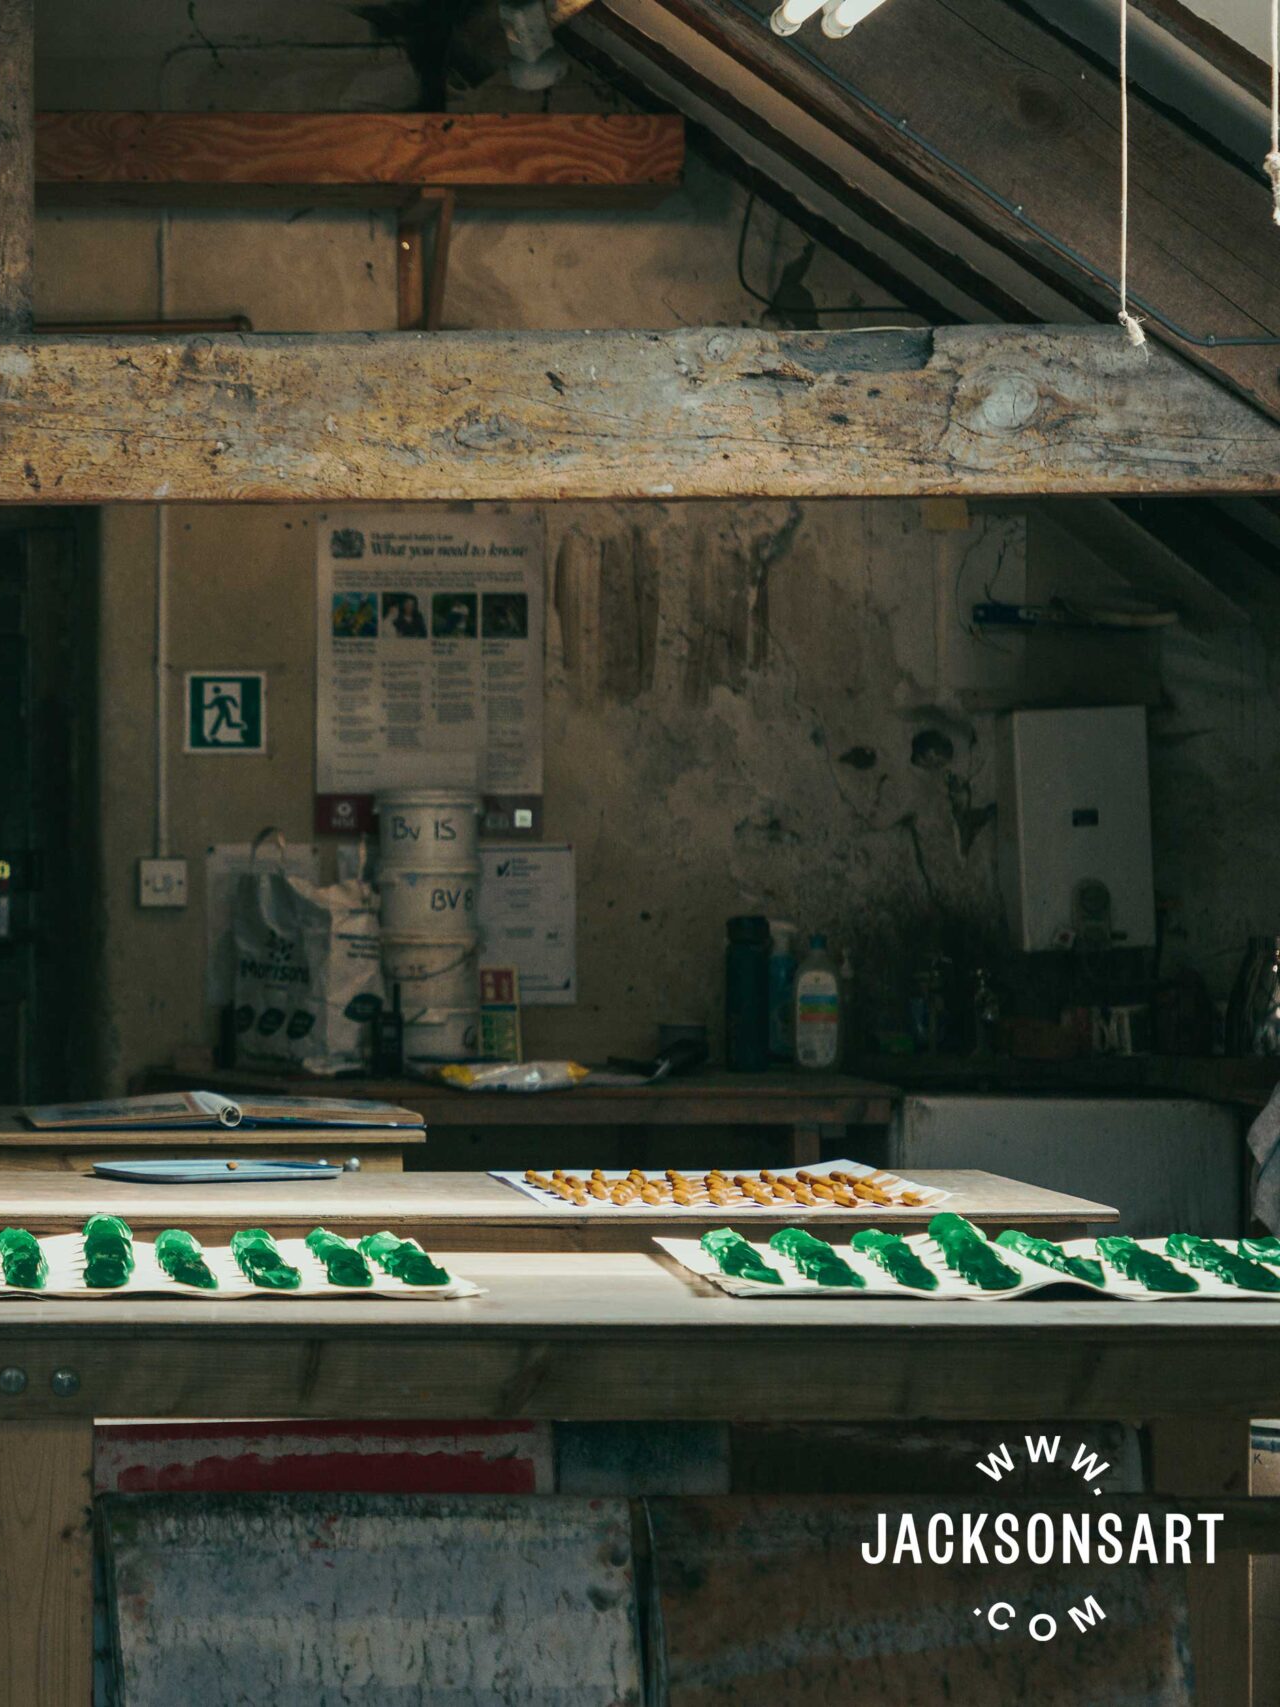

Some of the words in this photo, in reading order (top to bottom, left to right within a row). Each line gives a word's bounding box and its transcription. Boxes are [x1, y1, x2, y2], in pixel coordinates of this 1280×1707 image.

[371, 541, 406, 557] What
[409, 545, 434, 560] you
[437, 541, 469, 557] need
[471, 544, 486, 556] to
[488, 542, 528, 557] know
